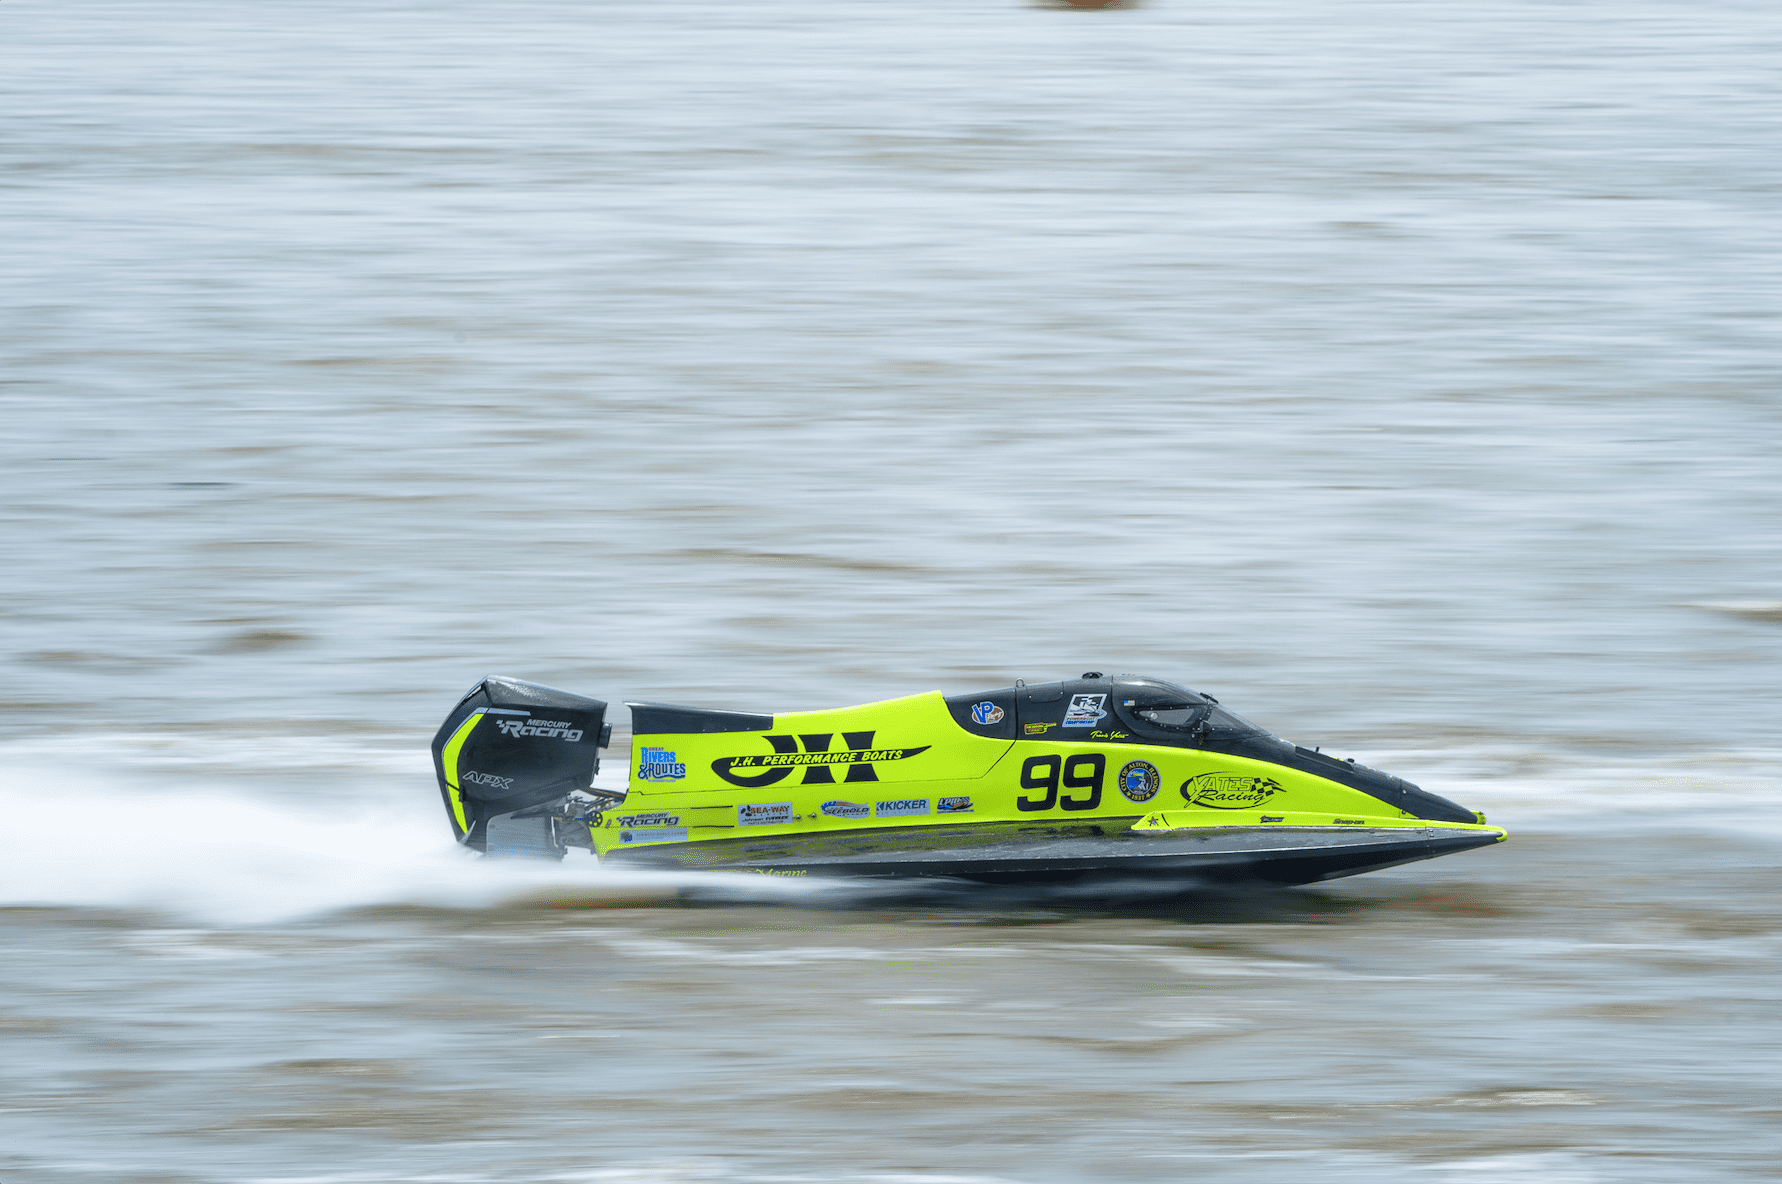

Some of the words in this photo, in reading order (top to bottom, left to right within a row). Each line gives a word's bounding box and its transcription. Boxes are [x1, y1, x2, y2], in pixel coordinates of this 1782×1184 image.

[972, 701, 994, 724] VP
[501, 720, 584, 742] Racing
[526, 719, 572, 729] MERCURY
[640, 746, 676, 763] RIVERS
[730, 757, 756, 767] J.H.
[762, 752, 857, 766] PERFORMANCE
[862, 750, 903, 761] BOATS
[462, 770, 514, 790] APX
[1016, 753, 1106, 812] 99
[1184, 776, 1254, 808] YATES
[1198, 789, 1265, 805] Racing
[885, 799, 926, 811] KICKER
[620, 815, 680, 828] Racing
